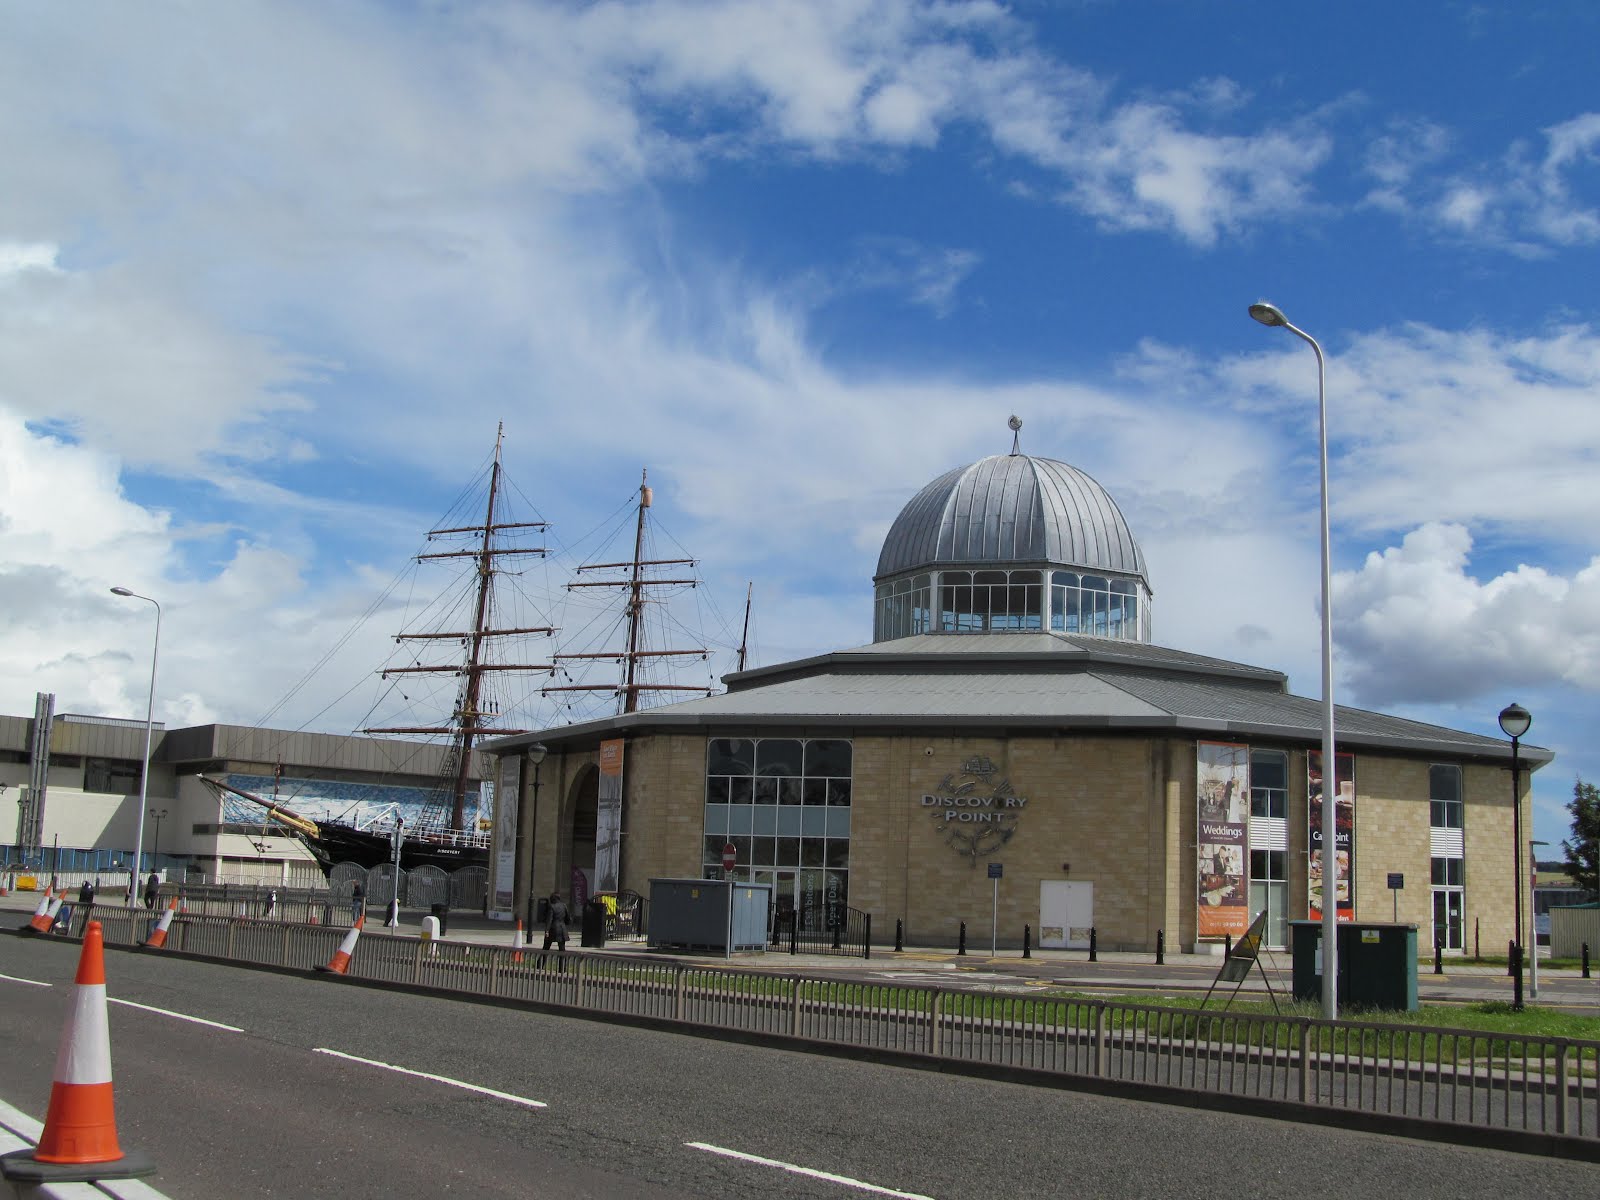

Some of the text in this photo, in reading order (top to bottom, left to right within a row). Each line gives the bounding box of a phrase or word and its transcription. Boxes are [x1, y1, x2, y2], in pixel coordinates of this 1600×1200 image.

[921, 794, 1027, 808] DISCOVRY
[945, 810, 1004, 822] POINT
[1203, 824, 1243, 839] Weddings
[828, 874, 839, 898] Daily
